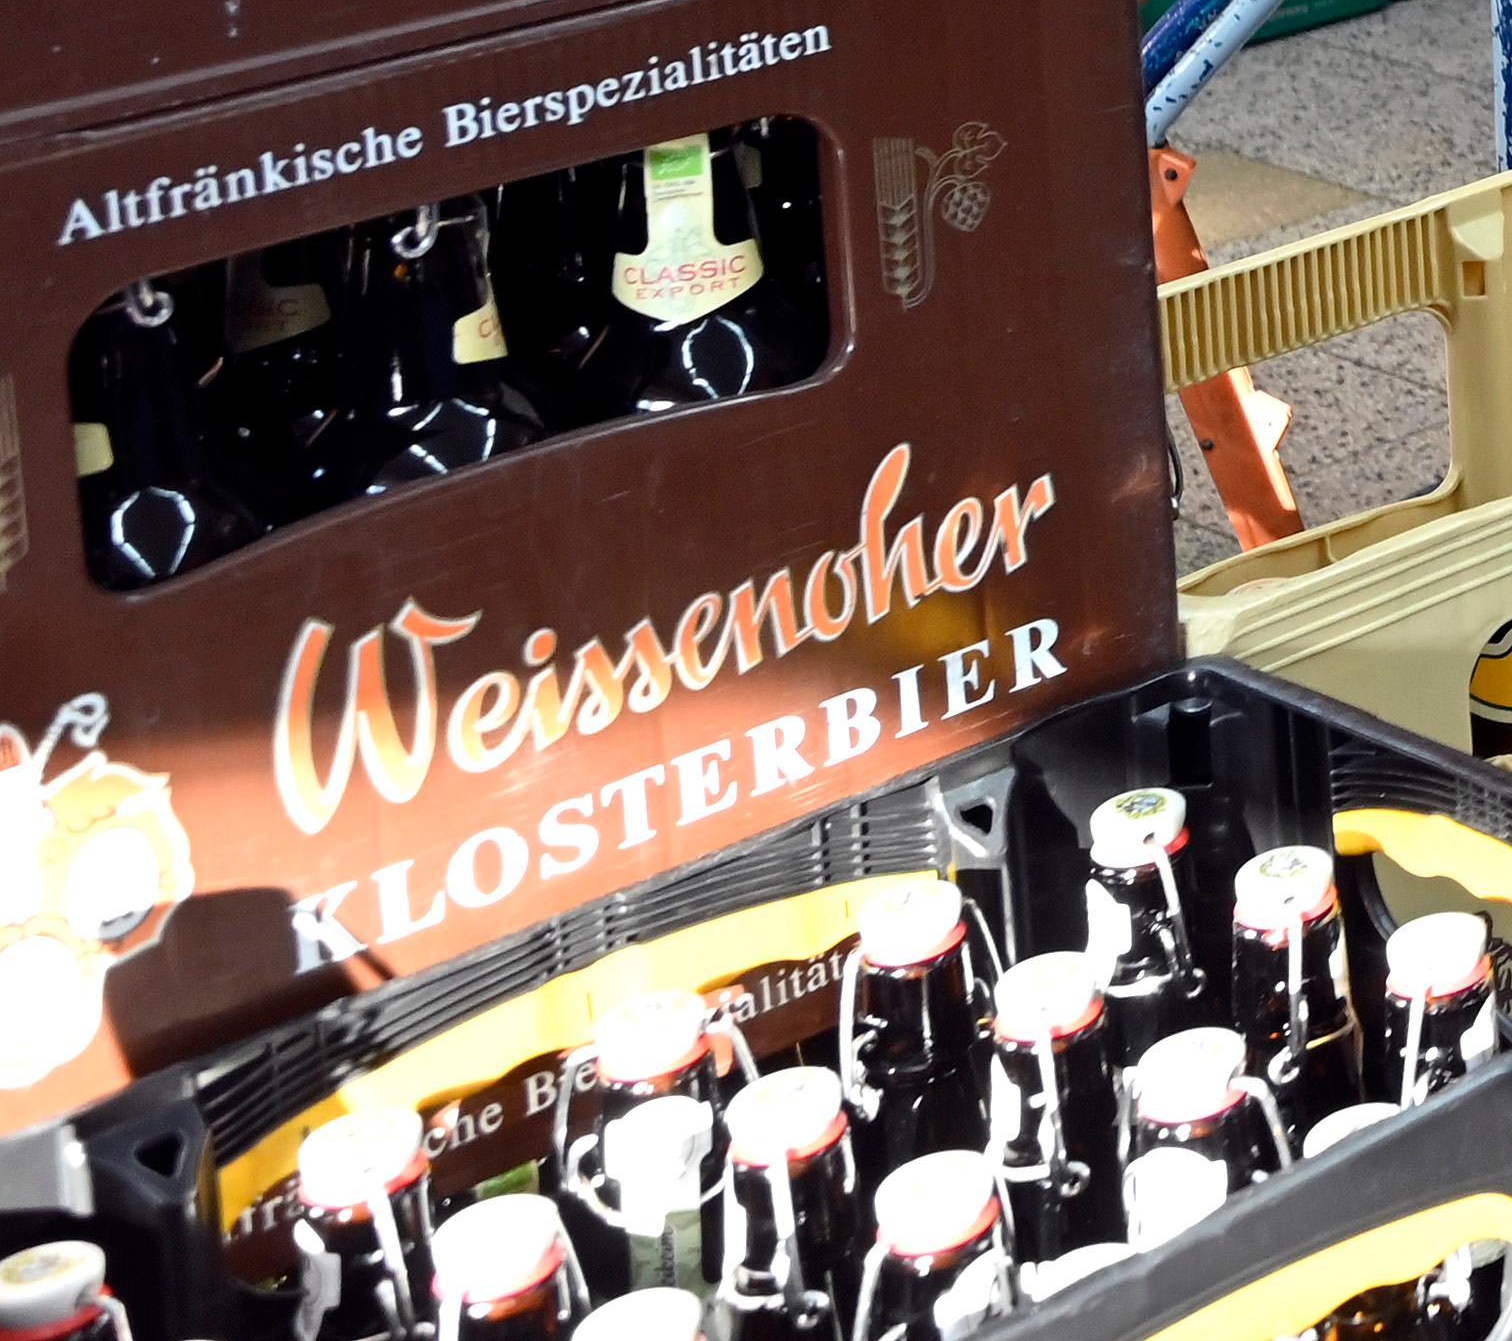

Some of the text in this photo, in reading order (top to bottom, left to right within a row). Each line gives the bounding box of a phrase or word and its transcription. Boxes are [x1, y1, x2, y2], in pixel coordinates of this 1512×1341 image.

[56, 22, 833, 247] Altfränkische Bierspezialitäten
[624, 253, 747, 286] CLASSIC
[634, 277, 743, 301] EXPORT
[272, 442, 1057, 835] Weissenoher
[291, 616, 1070, 973] KLOSTERBIER
